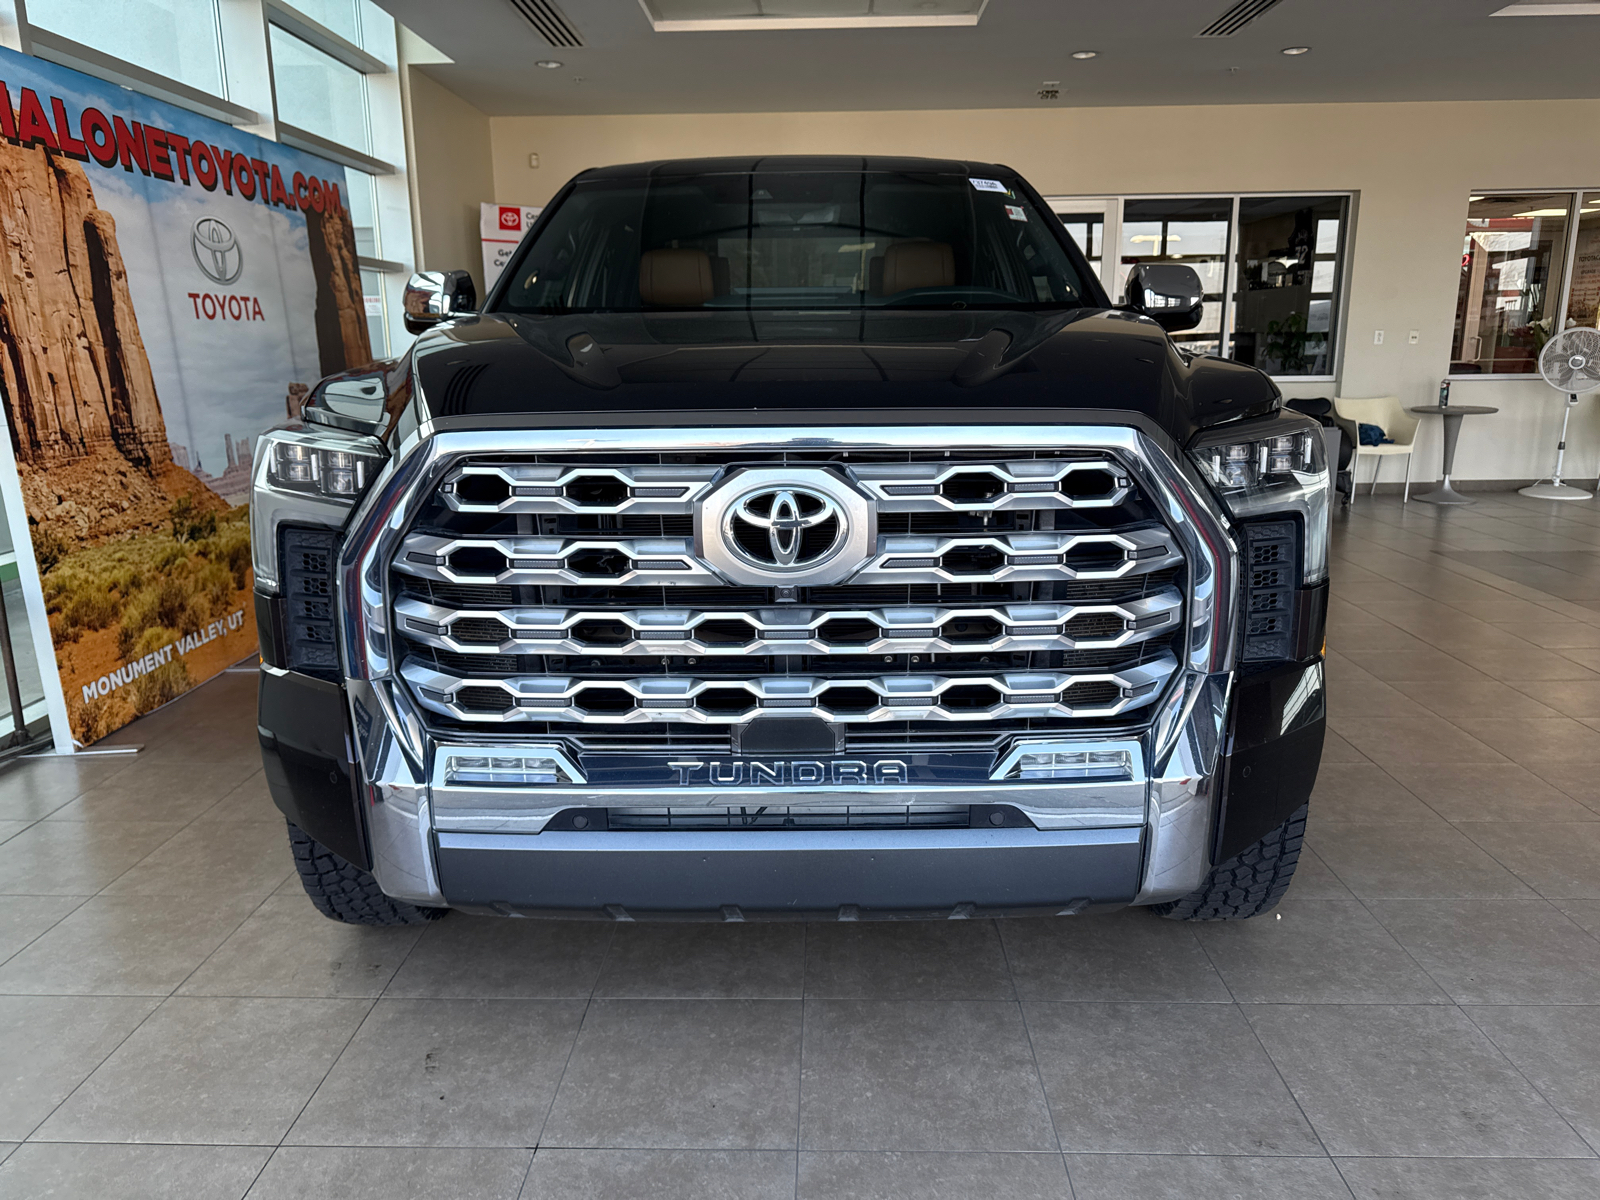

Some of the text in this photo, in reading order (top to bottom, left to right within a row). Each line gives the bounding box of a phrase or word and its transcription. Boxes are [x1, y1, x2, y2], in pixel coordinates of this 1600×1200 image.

[187, 292, 265, 322] TOYOTA
[81, 609, 244, 704] MONUMENT VALLEY, UT
[666, 759, 909, 786] TUNDRA
